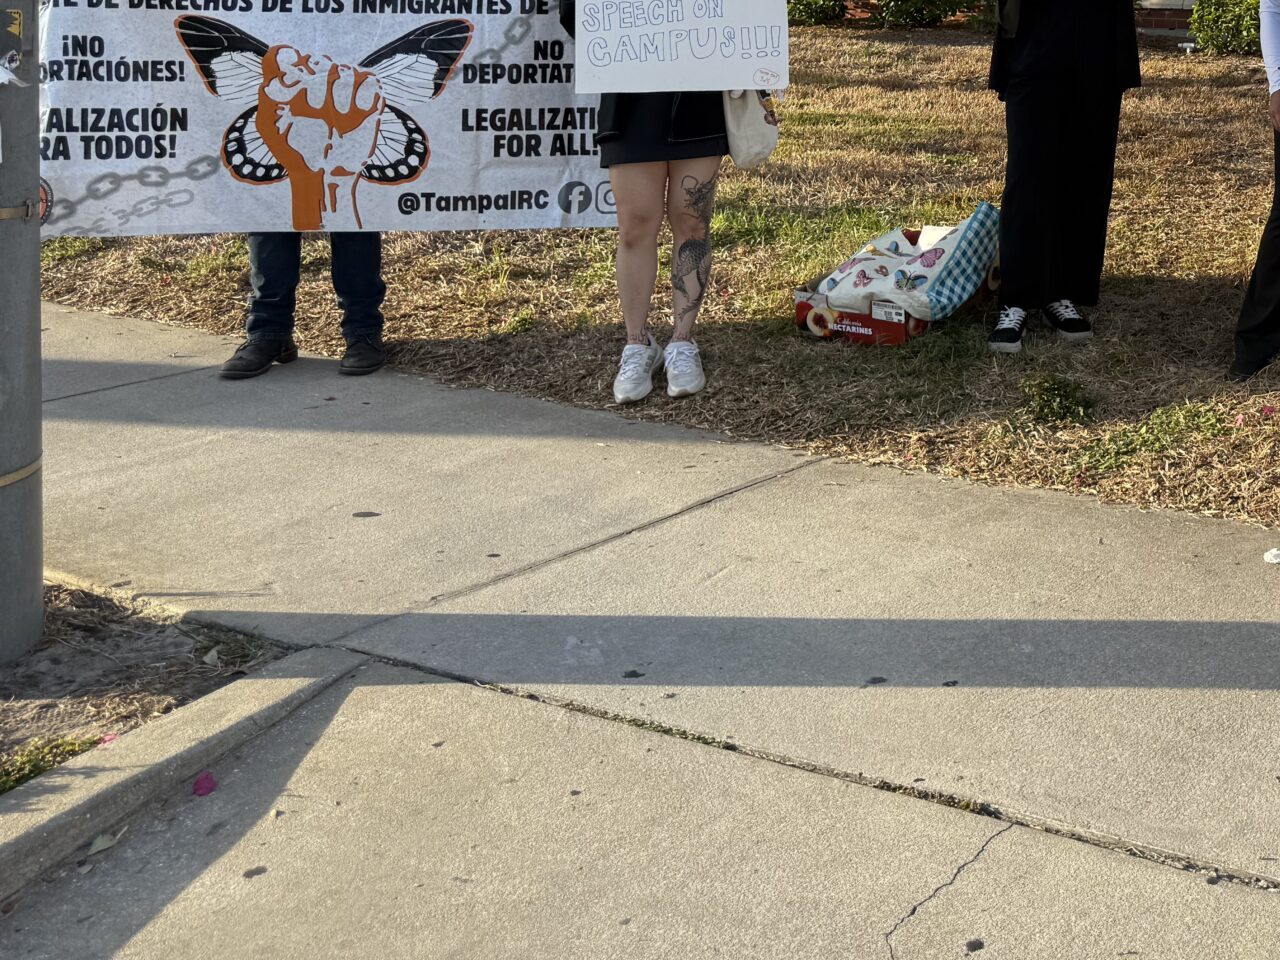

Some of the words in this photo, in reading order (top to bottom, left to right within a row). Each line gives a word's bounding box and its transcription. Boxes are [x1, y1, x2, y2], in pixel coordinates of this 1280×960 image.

[581, 0, 685, 33] SPEECH
[62, 34, 105, 58] ¡NO
[533, 40, 564, 60] NO
[586, 25, 782, 68] CAMPUS!!!
[462, 63, 574, 84] DEPORTAT
[80, 134, 177, 160] TODOS!
[493, 134, 542, 157] FOR
[397, 190, 550, 215] @TampaIRC
[828, 323, 873, 335] NECTARINES
